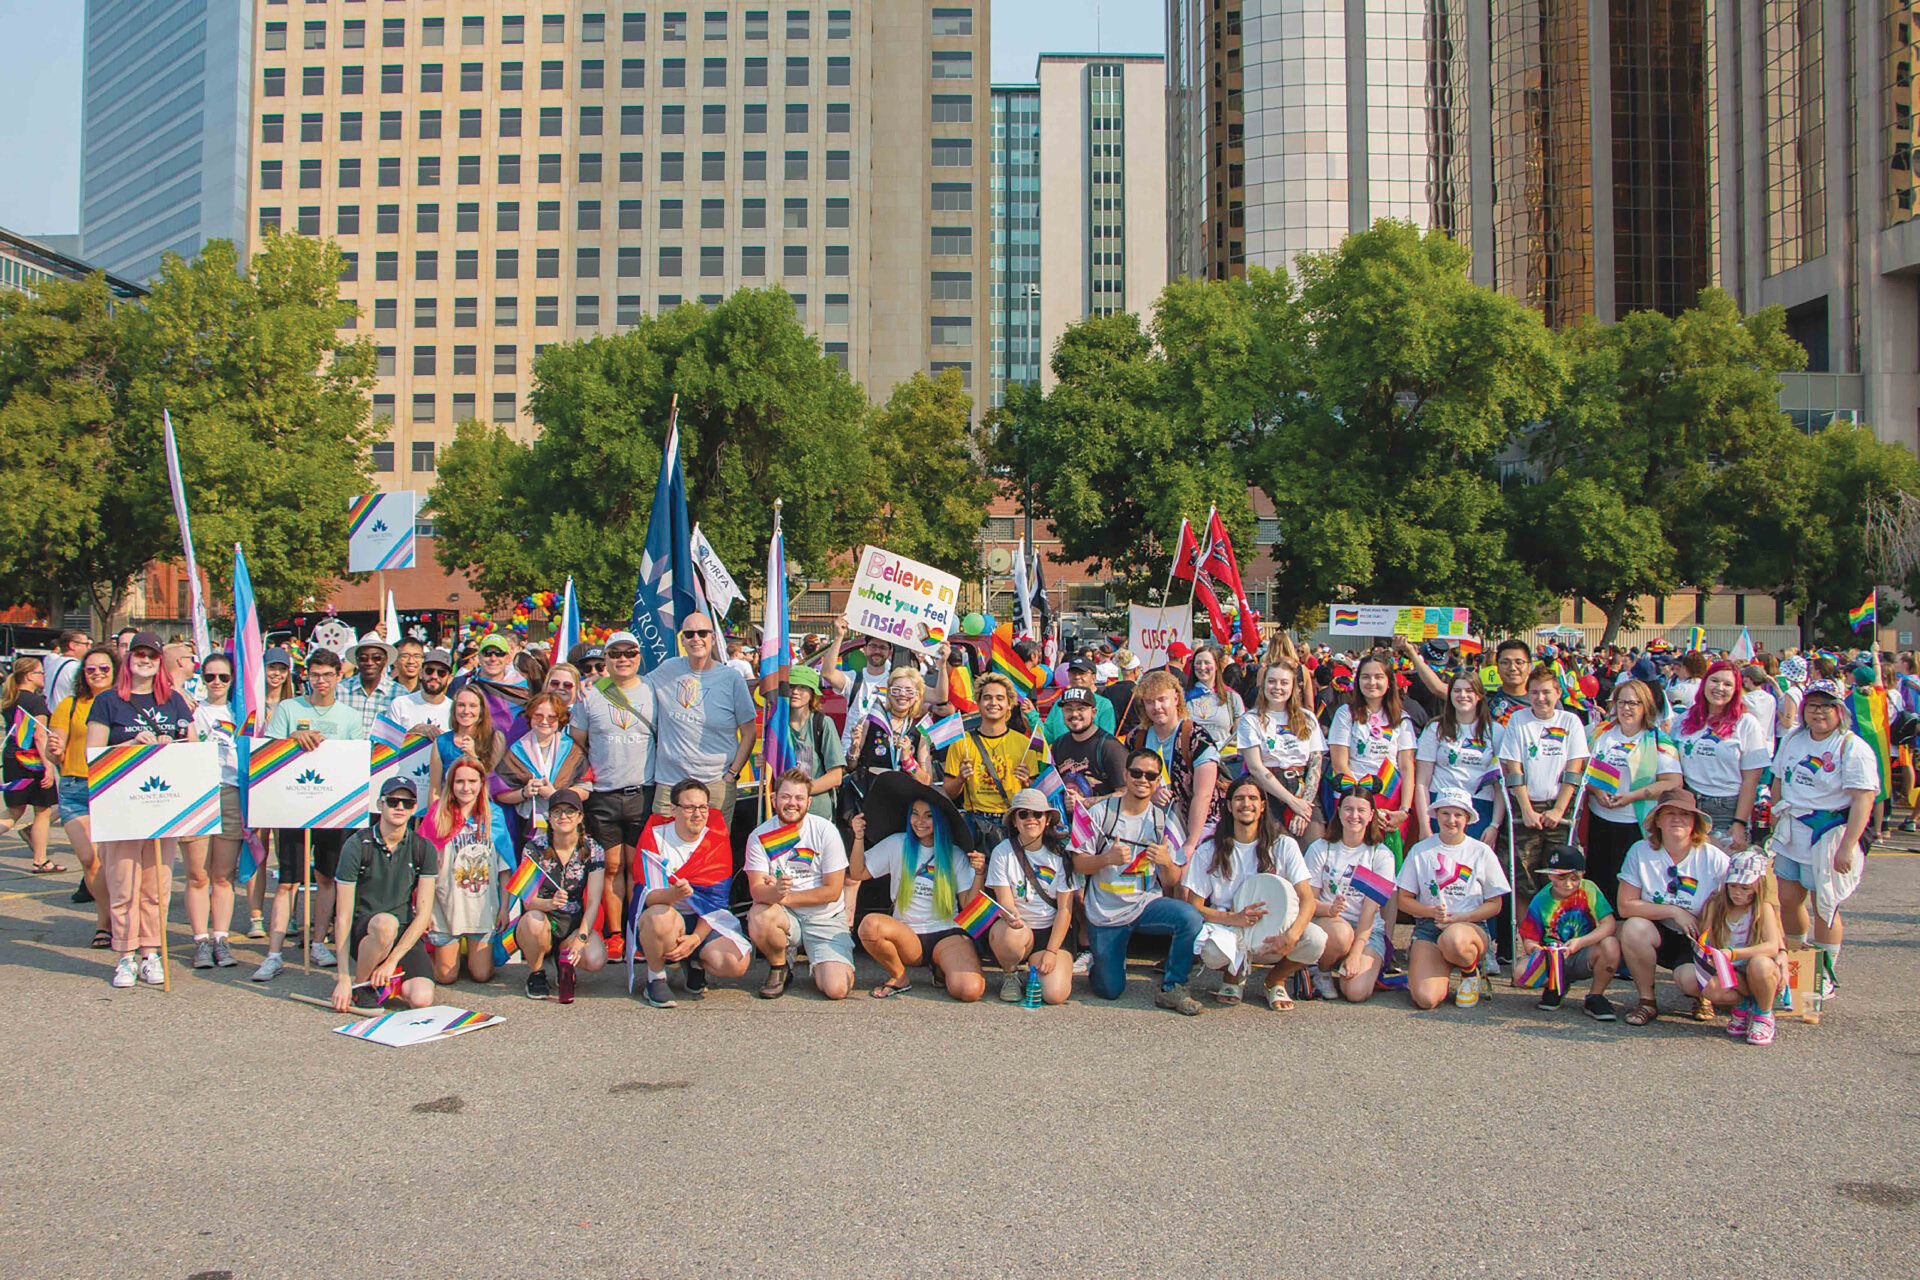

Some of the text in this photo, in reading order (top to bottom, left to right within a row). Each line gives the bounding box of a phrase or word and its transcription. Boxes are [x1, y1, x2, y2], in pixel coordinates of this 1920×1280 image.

[705, 561, 729, 588] MRFA
[866, 552, 953, 605] Believe in
[857, 584, 948, 625] what you feel
[861, 609, 913, 640] inside
[1141, 628, 1168, 651] CIBC
[1064, 688, 1086, 700] THEY
[124, 725, 153, 733] MOUN
[669, 711, 702, 725] PRIDE
[608, 735, 642, 744] PRIDE
